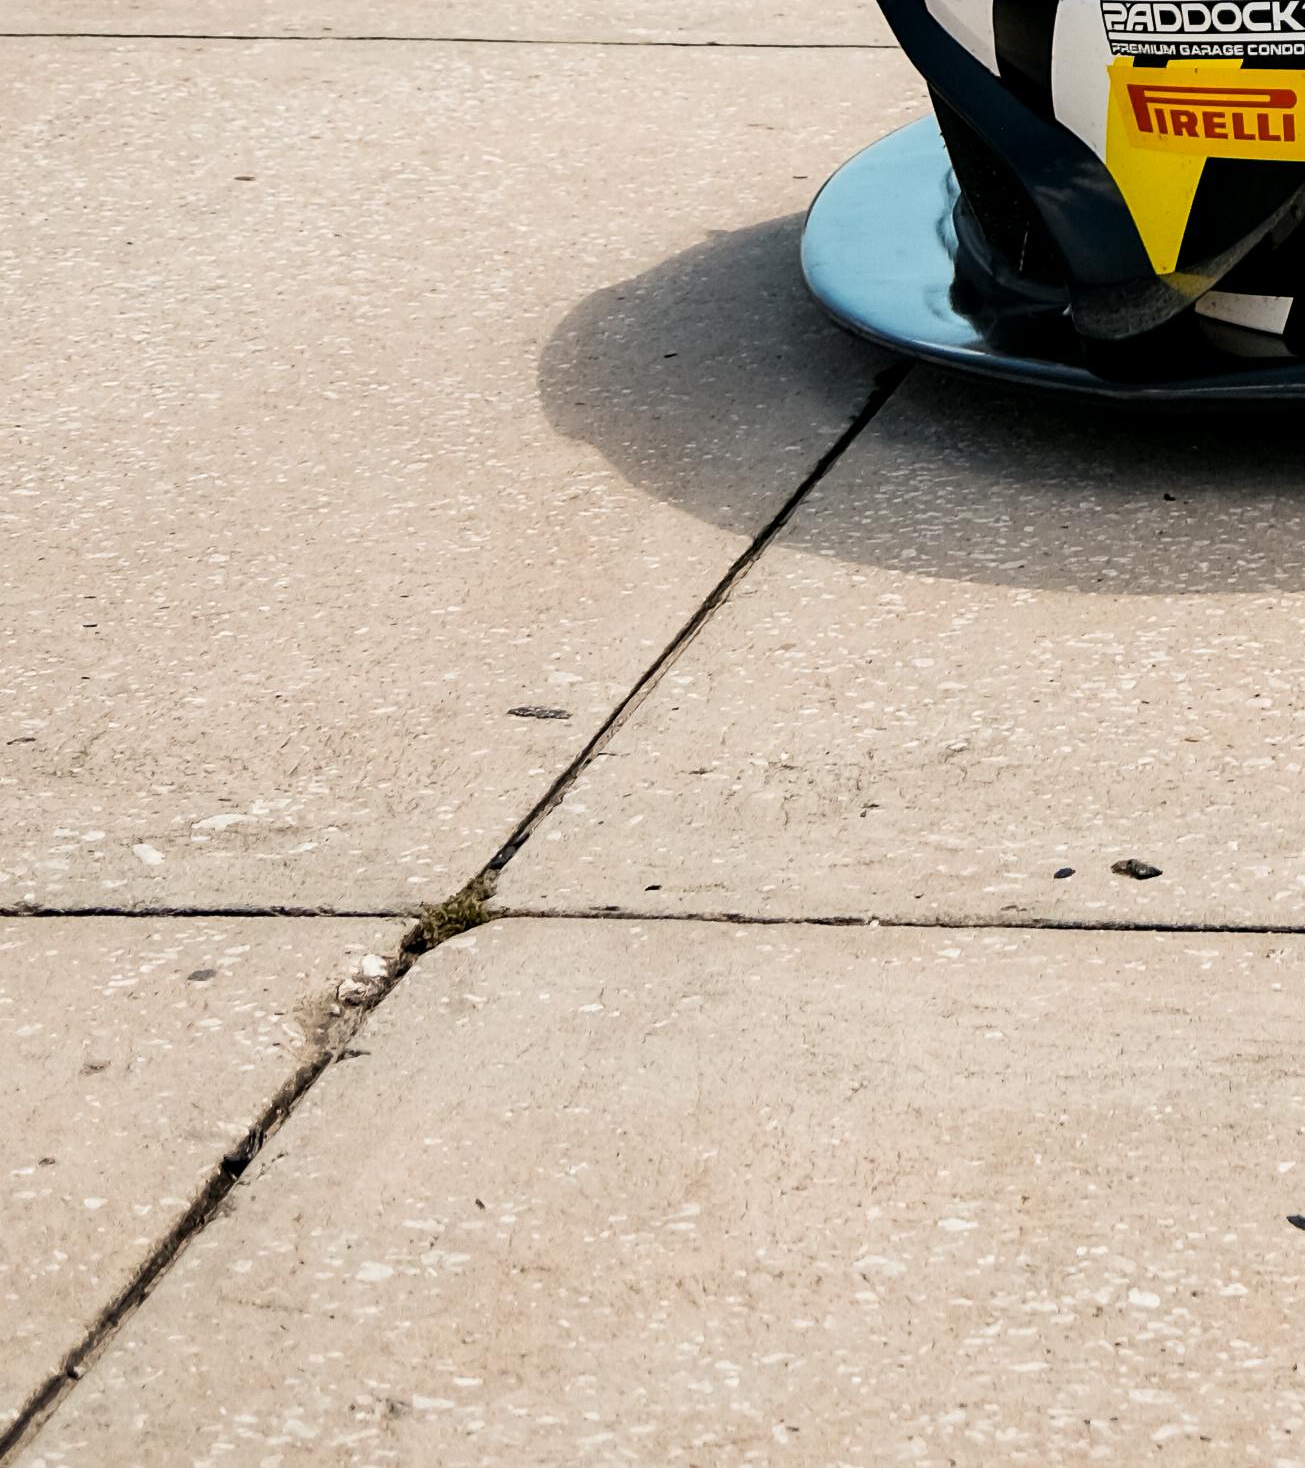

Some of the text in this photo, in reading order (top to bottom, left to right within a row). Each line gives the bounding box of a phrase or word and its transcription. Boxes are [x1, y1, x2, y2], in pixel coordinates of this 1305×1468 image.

[1111, 42, 1176, 56] PREMIUM
[1179, 42, 1243, 56] GARAGE
[1126, 84, 1297, 142] PIRELLI
